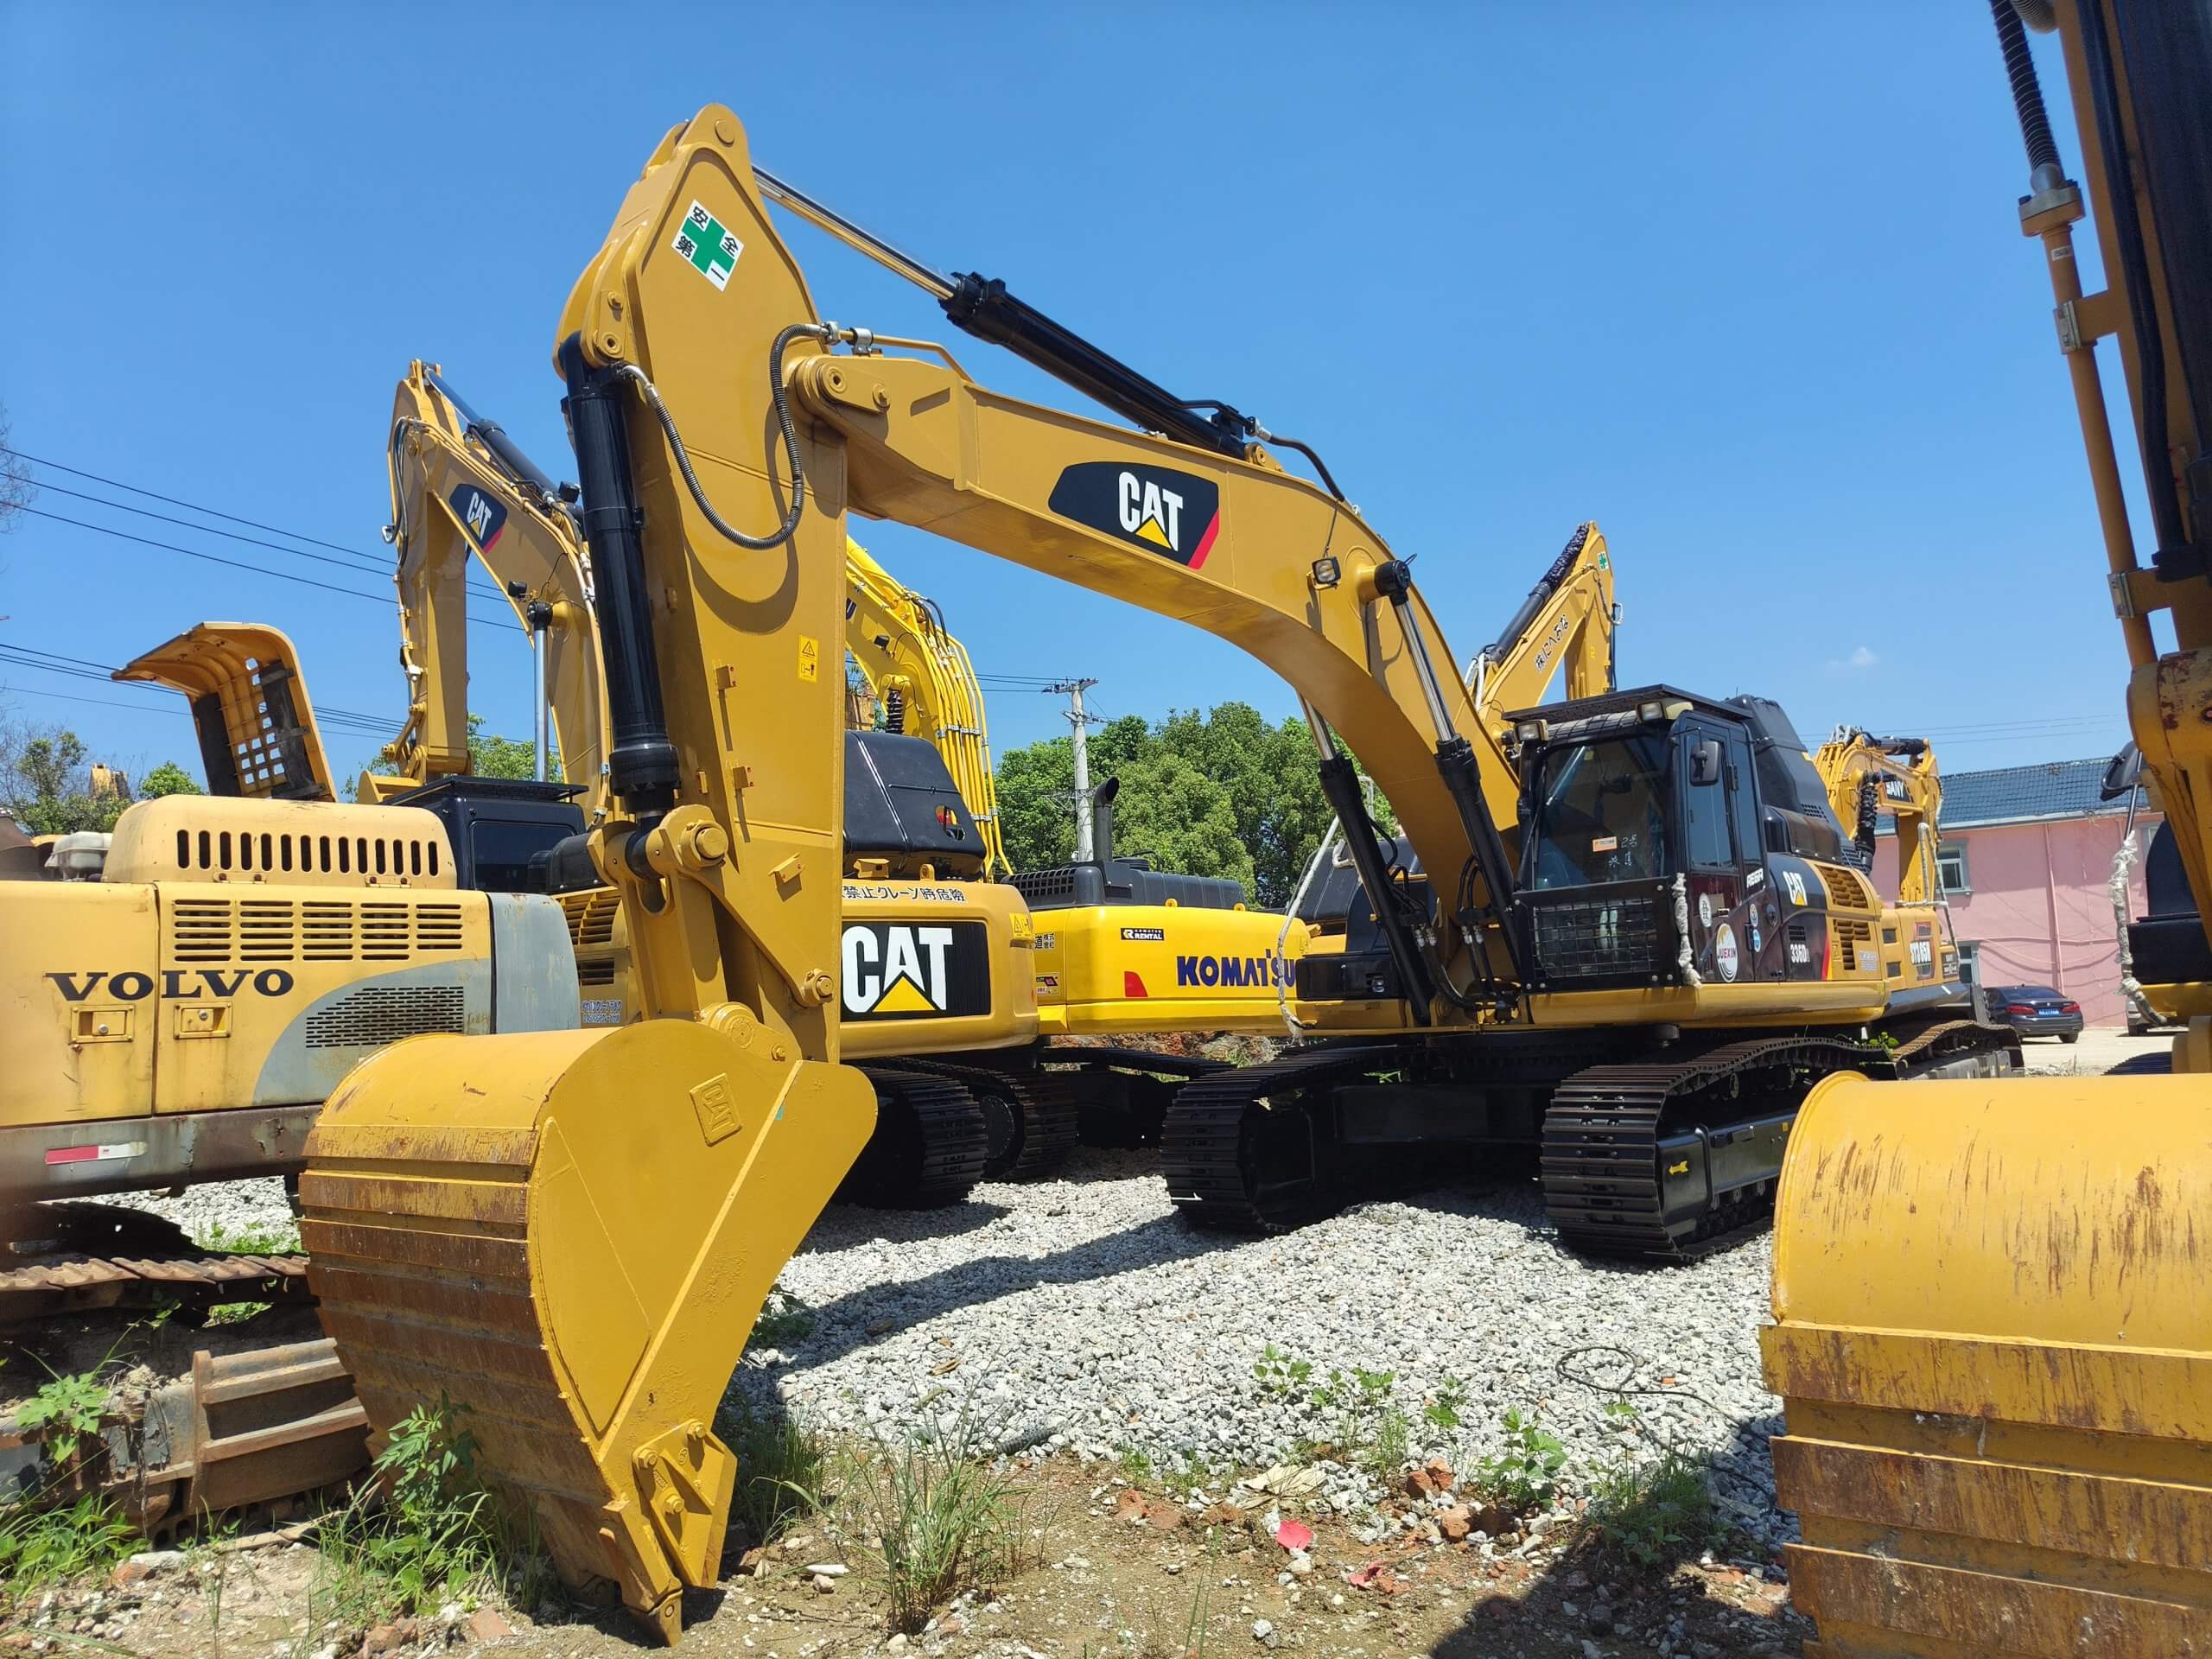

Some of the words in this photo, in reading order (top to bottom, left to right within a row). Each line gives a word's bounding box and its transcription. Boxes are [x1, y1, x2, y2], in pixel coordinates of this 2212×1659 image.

[467, 492, 493, 540] CAT
[1119, 472, 1183, 551] CAT
[842, 886, 966, 901] 禁止クレーン時危険
[1783, 871, 1808, 906] CAT
[43, 969, 294, 1001] VOLVO
[842, 926, 953, 1012] CAT
[1177, 949, 1295, 987] KOMATSU
